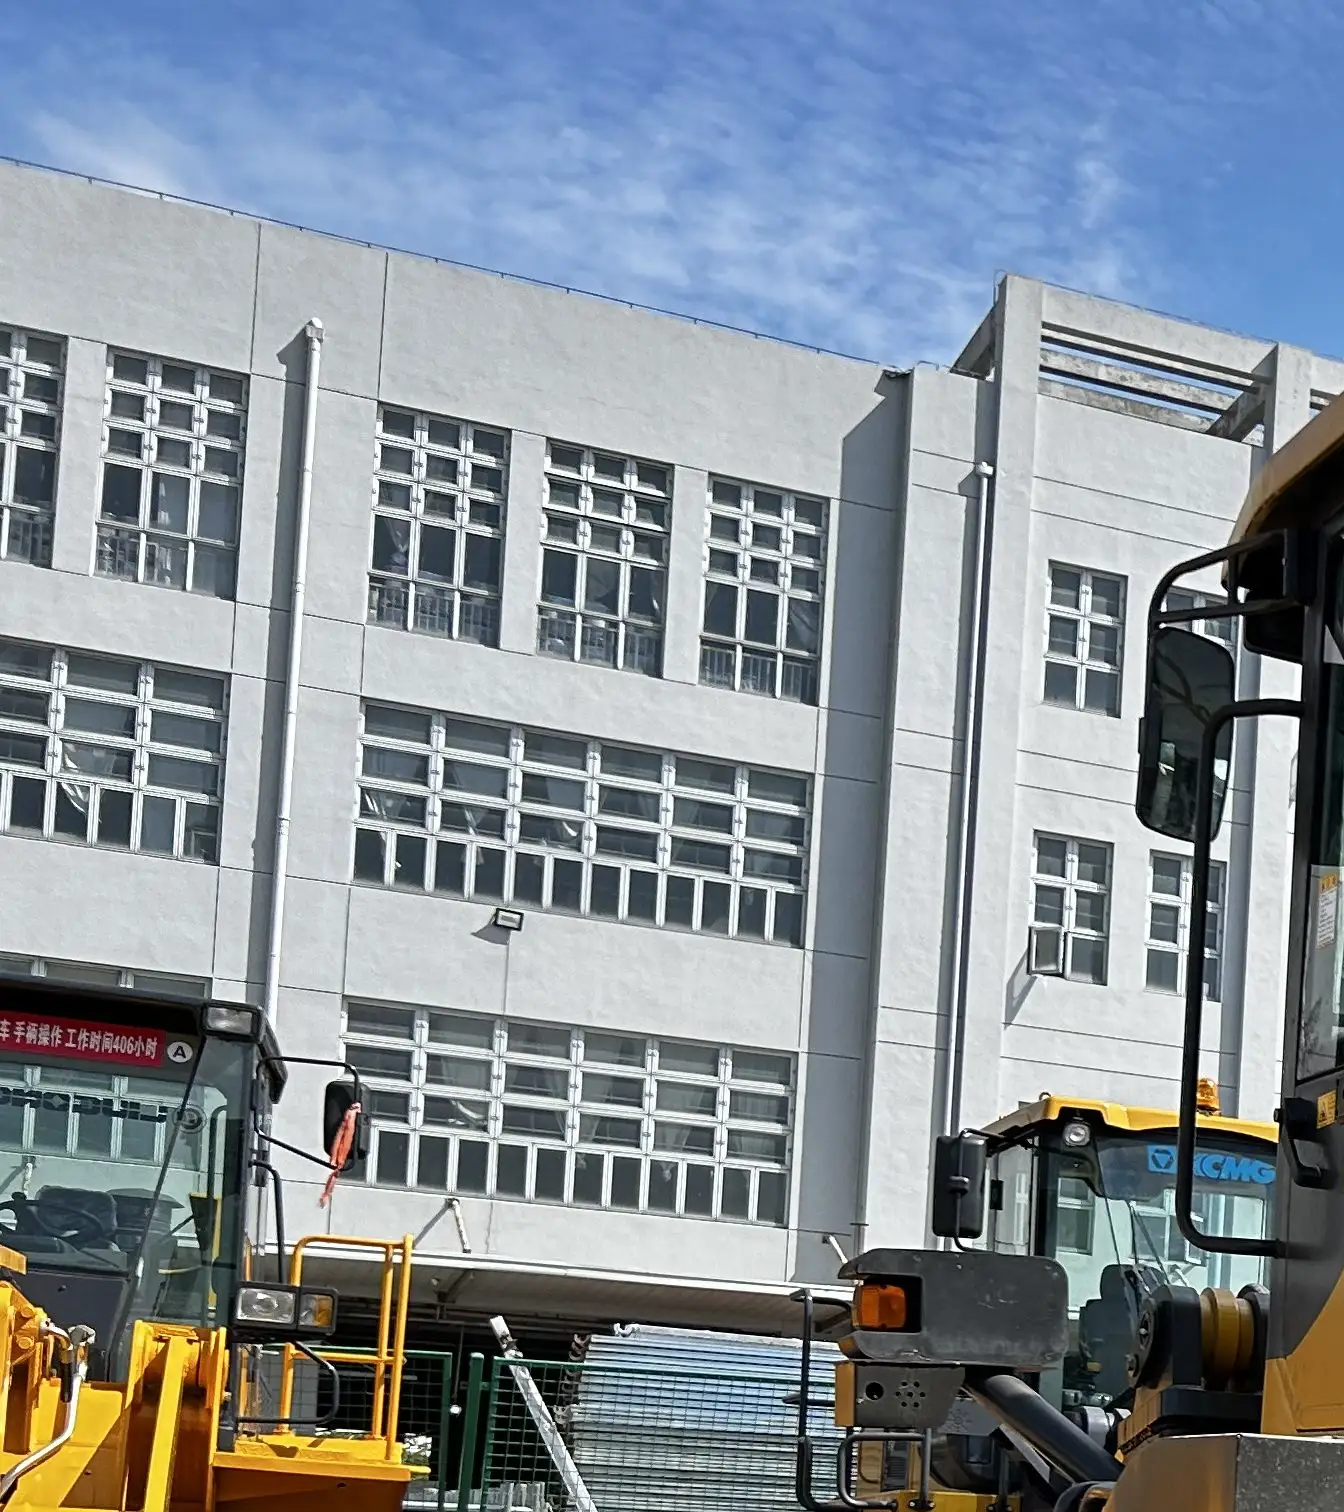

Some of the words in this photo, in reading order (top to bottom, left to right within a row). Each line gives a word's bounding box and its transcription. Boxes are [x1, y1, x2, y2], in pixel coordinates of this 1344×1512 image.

[65, 1028, 158, 1060] 工作时间406小时
[172, 1045, 187, 1058] A
